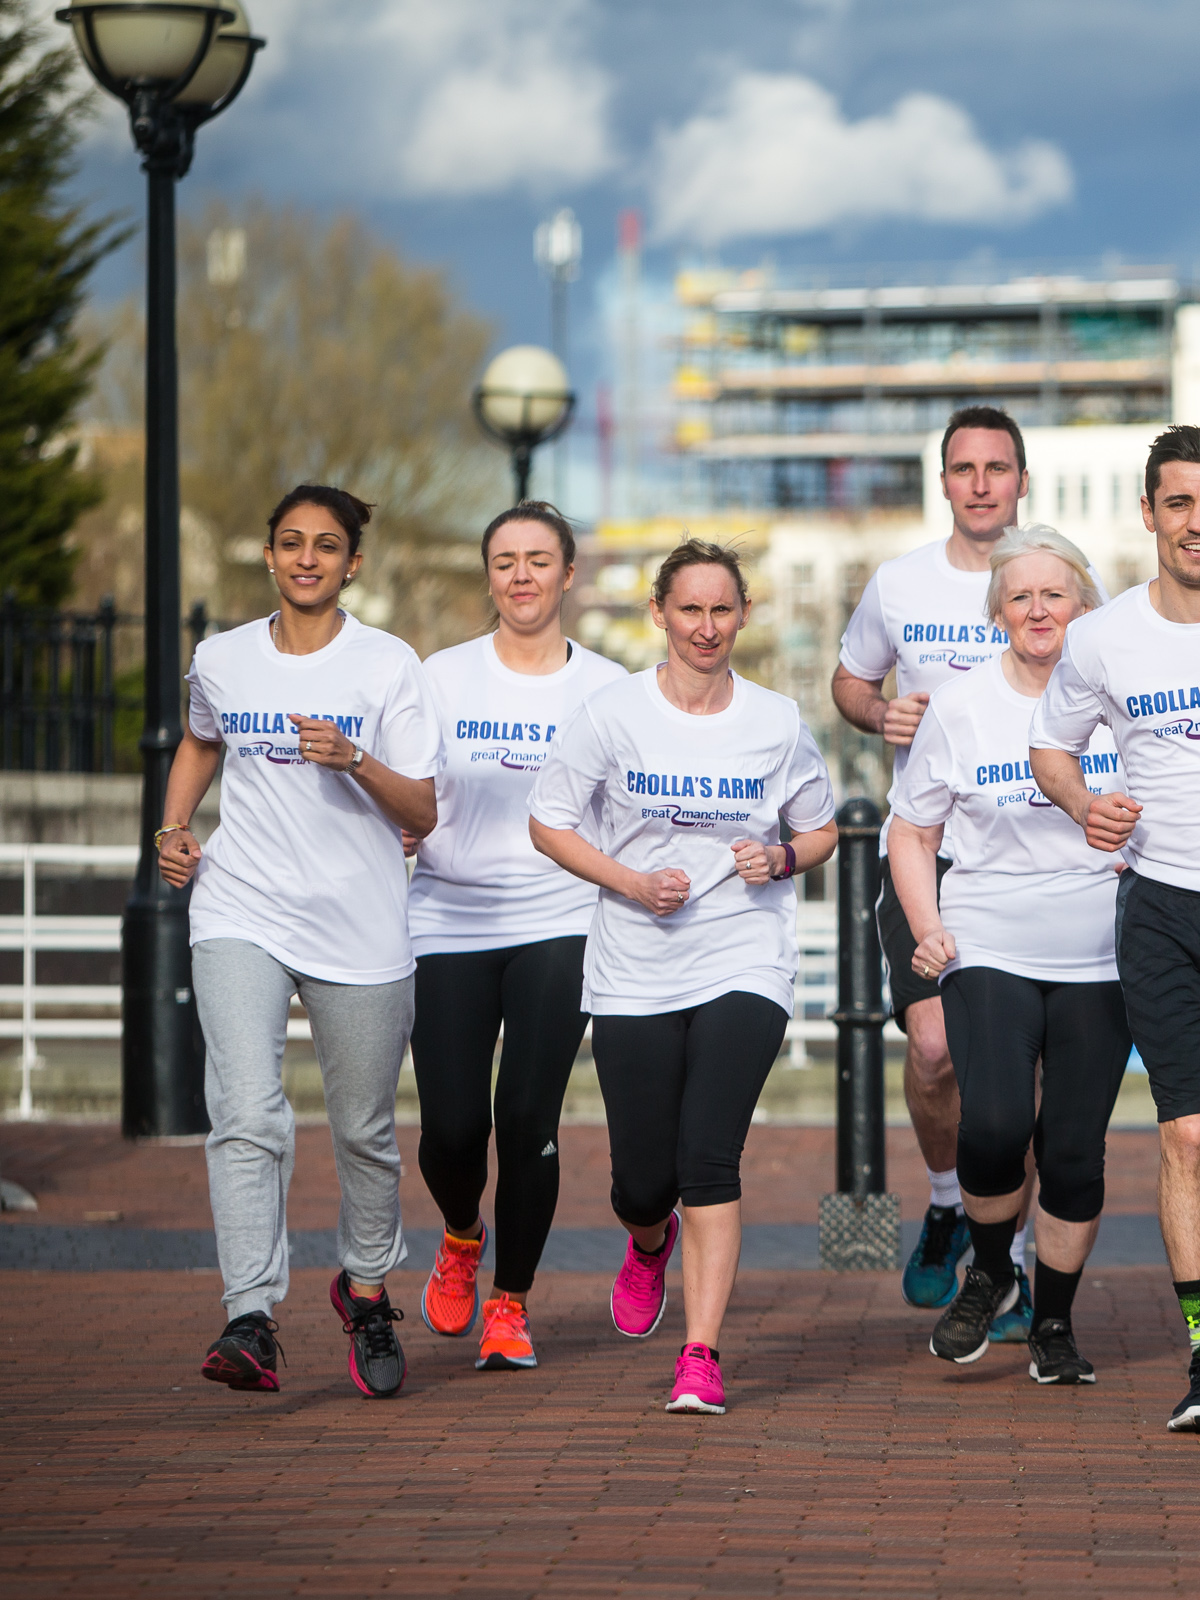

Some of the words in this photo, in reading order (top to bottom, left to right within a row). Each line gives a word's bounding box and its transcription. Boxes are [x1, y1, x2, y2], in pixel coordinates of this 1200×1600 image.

[903, 624, 986, 643] CROLLA'S
[919, 653, 947, 664] great
[456, 720, 541, 742] CROLLA'S
[1153, 723, 1184, 738] great
[238, 745, 265, 757] great
[471, 750, 500, 762] great
[976, 760, 1035, 785] CROLL
[1079, 752, 1119, 774] RMY
[627, 770, 713, 798] CROLLA'S
[717, 778, 766, 799] ARMY
[997, 791, 1026, 807] great
[641, 808, 670, 819] great
[681, 808, 751, 821] manchester
